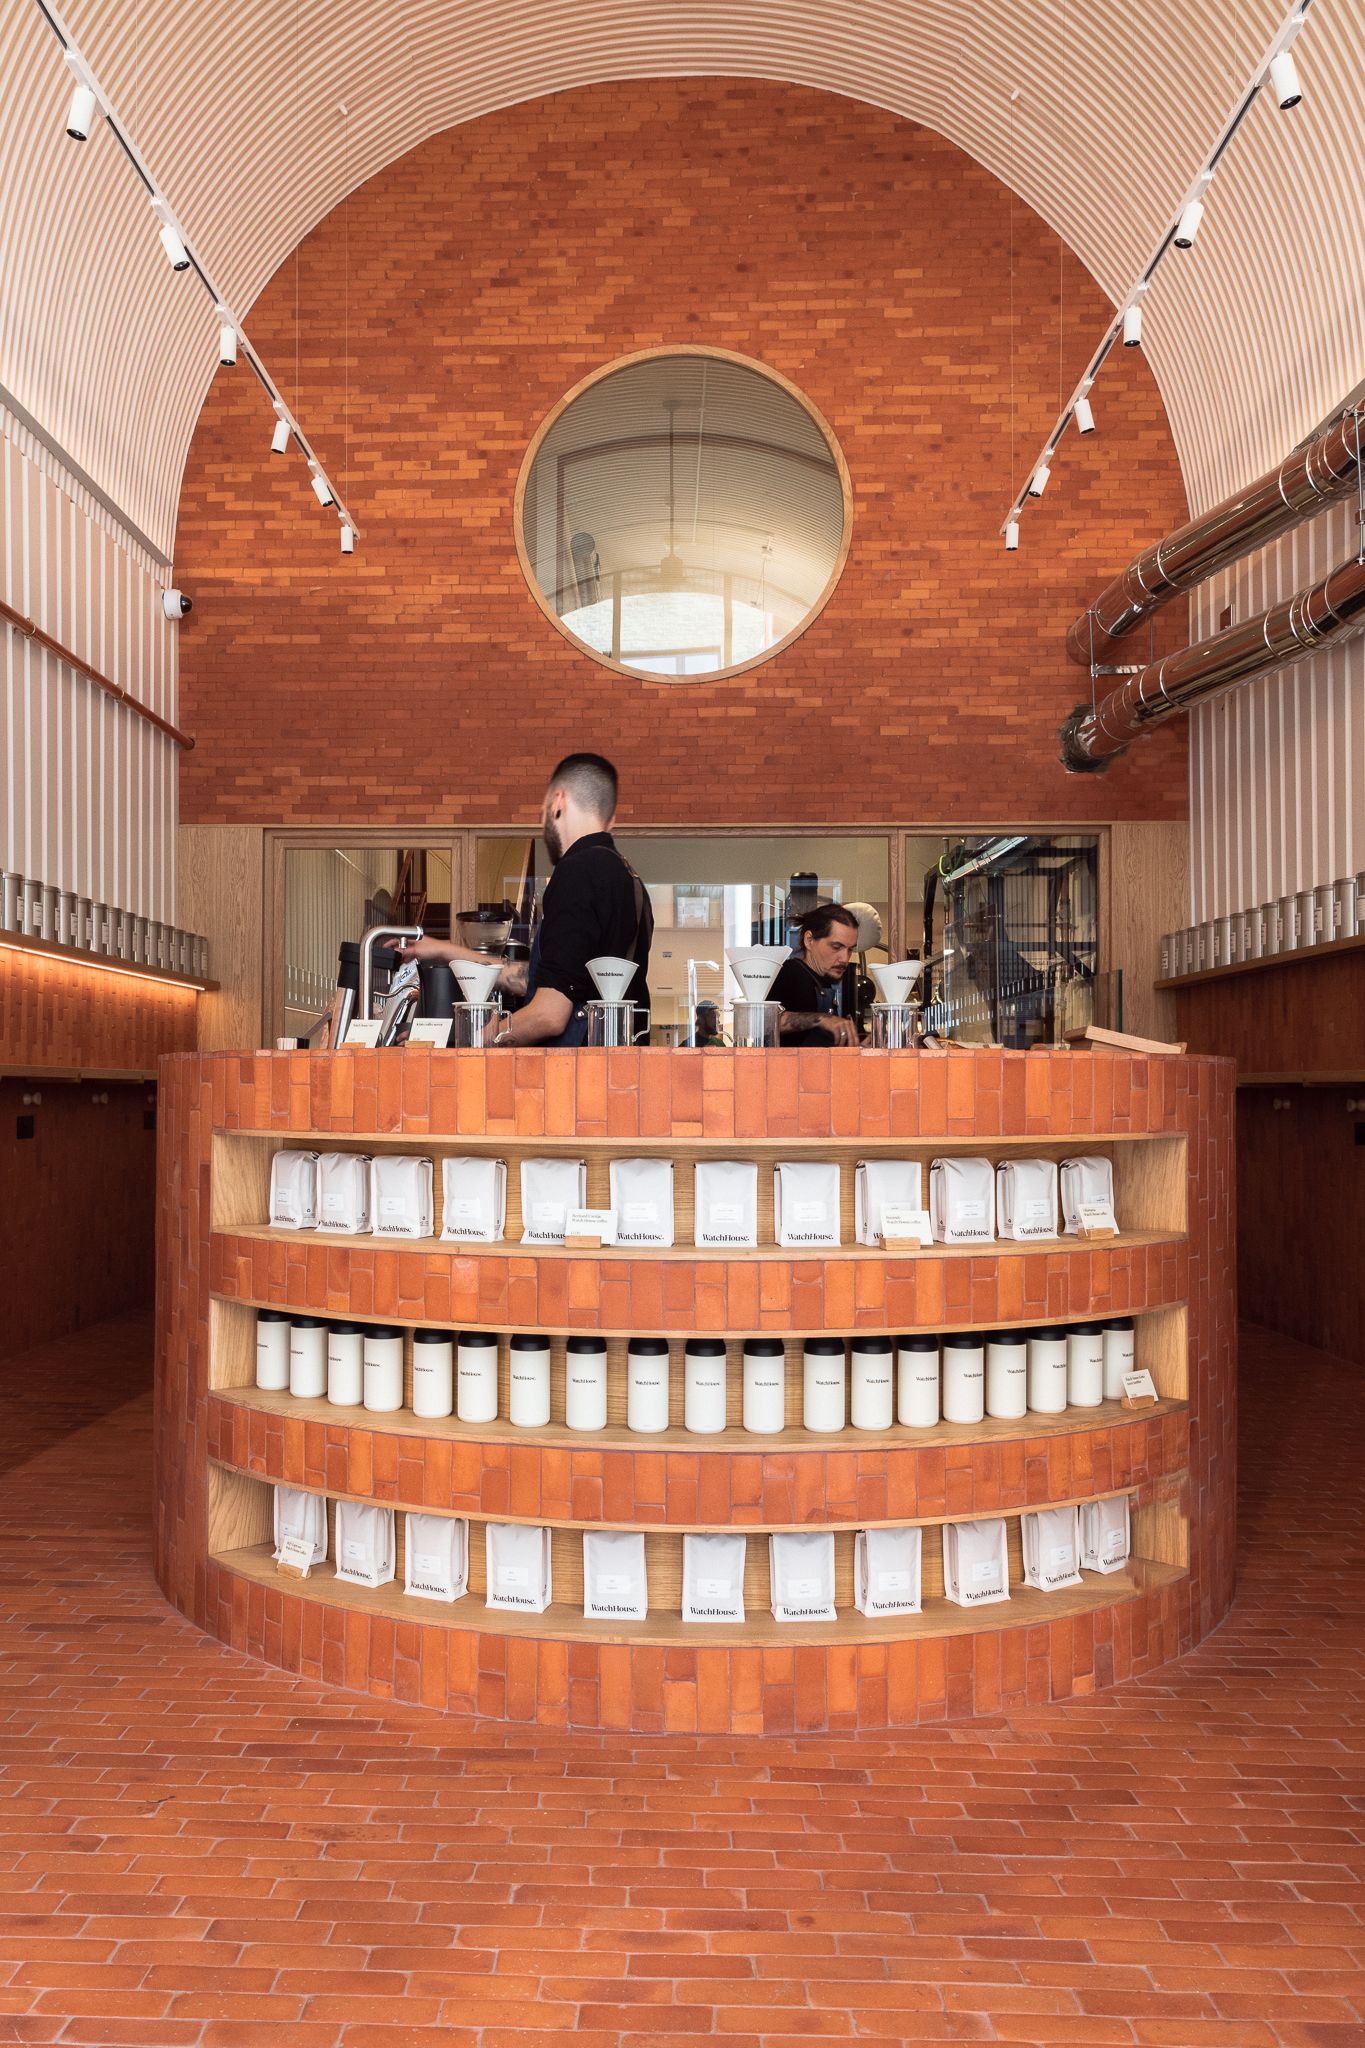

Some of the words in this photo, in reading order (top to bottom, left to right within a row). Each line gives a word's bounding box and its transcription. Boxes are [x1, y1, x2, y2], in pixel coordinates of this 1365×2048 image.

[528, 1231, 566, 1239] WatchHous
[617, 1232, 665, 1240] WatchHouse.
[702, 1233, 750, 1242] WatchHouse.
[787, 1232, 834, 1241] WatchHouse.
[966, 1588, 1003, 1599] WatchHouse.
[493, 1594, 537, 1605] WatchHouse.
[591, 1603, 639, 1613] WatchHouse.
[872, 1600, 916, 1610] WatchHouse.
[690, 1606, 738, 1616] WatchHouse.
[783, 1607, 830, 1616] WatchHouse.
